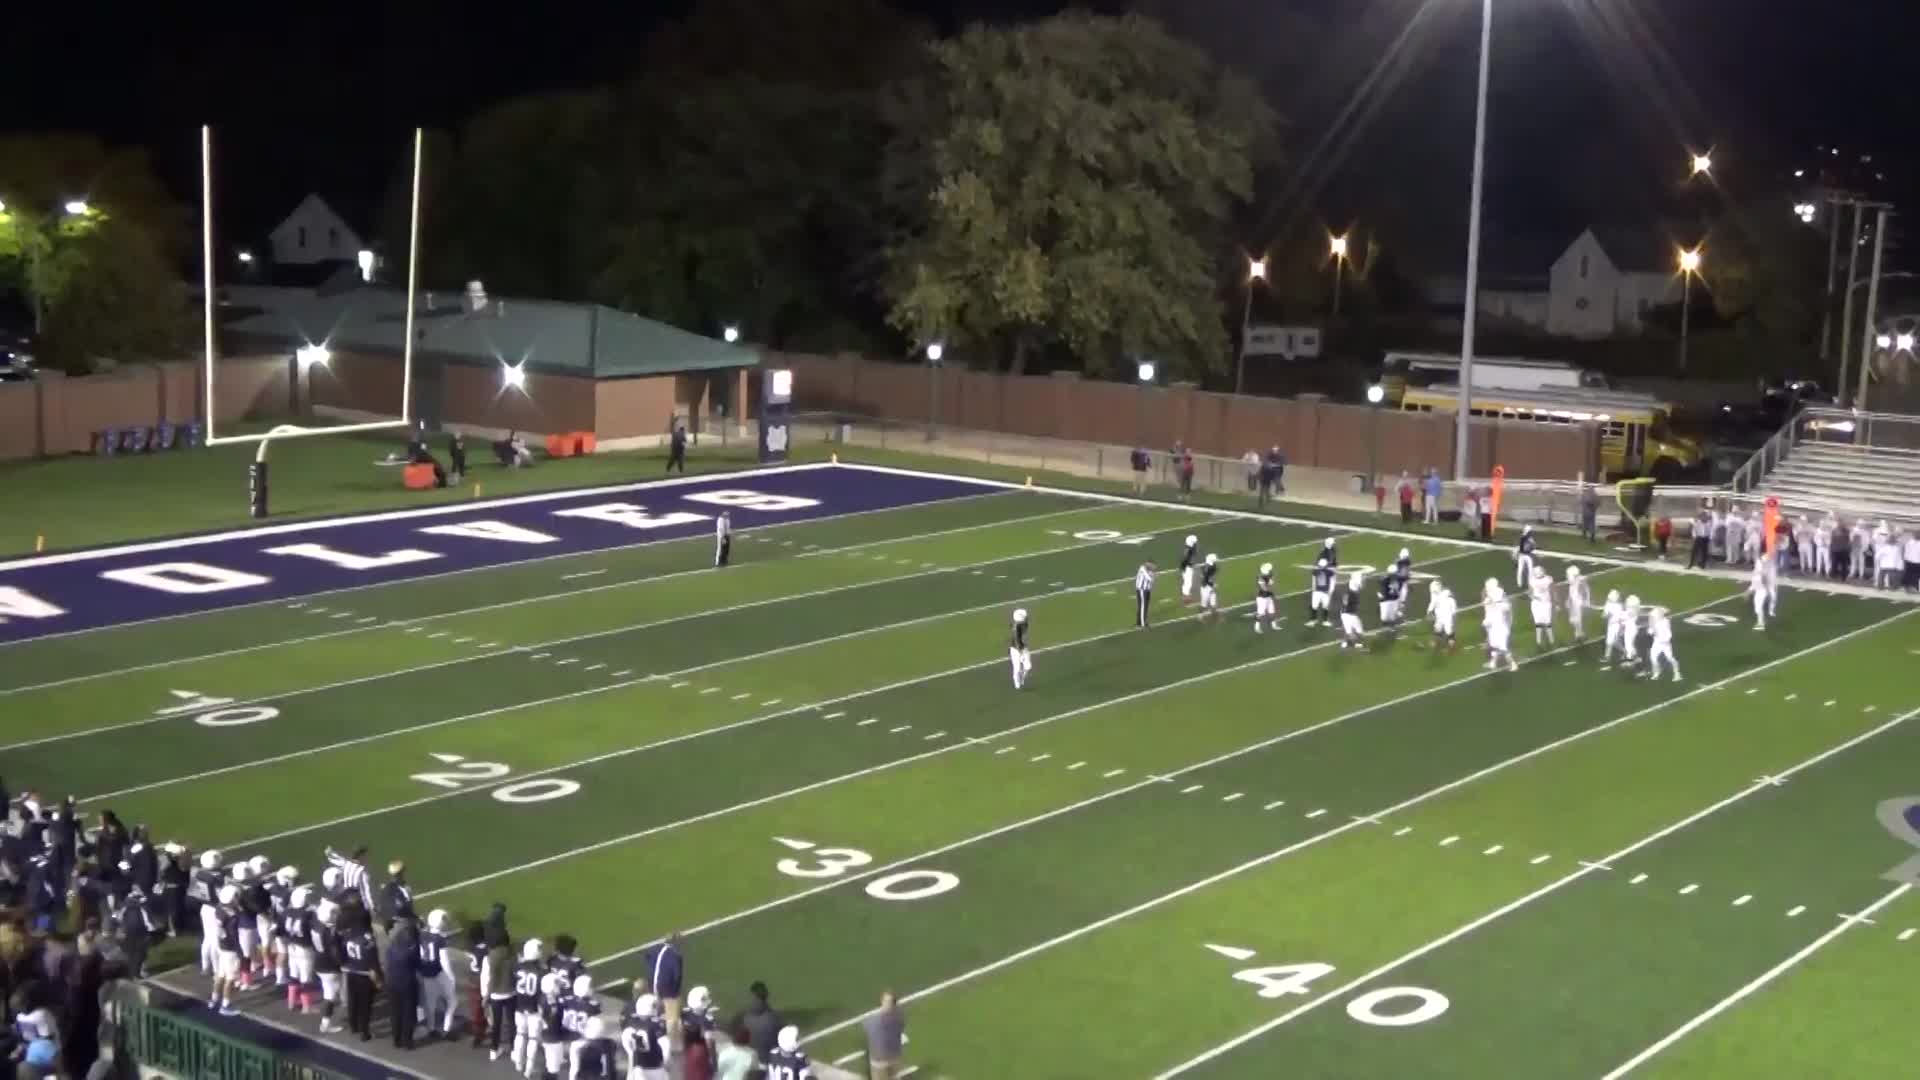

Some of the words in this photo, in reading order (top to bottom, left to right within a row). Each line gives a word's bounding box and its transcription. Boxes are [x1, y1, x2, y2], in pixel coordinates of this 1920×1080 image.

[154, 695, 280, 727] 10
[409, 762, 581, 803] 20
[776, 847, 960, 901] 30
[516, 969, 538, 997] 20
[1231, 962, 1450, 1027] 40
